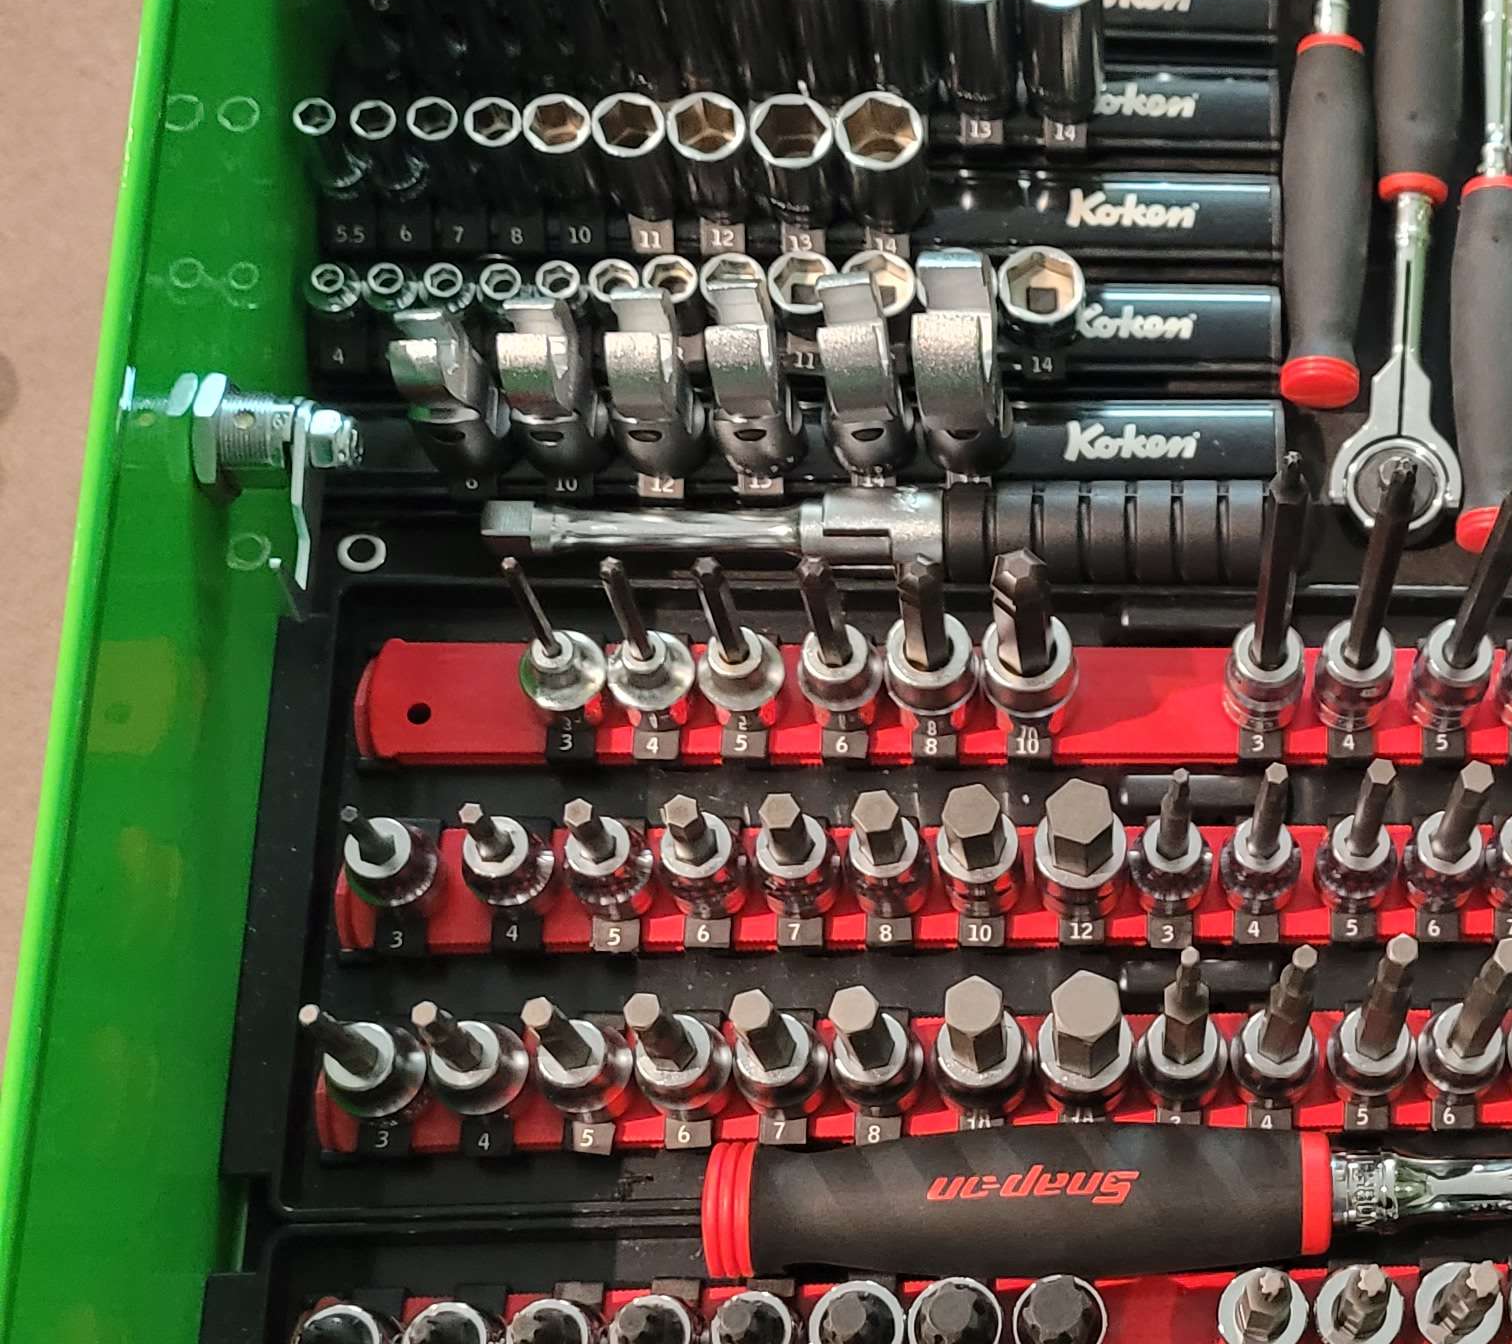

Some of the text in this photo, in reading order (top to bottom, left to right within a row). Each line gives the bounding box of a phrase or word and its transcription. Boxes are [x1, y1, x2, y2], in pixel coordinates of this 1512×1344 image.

[969, 121, 992, 139] 13
[1054, 124, 1076, 142] 14
[1067, 188, 1199, 229] Koken
[400, 226, 412, 242] 6
[454, 225, 465, 243] 7
[511, 227, 523, 245] 8
[568, 225, 592, 244] 10
[640, 230, 662, 249] 11
[710, 228, 734, 248] 12
[788, 234, 813, 252] 13
[332, 347, 345, 365] 4
[1031, 357, 1054, 374] 14
[1065, 421, 1199, 461] Koken
[560, 734, 572, 751] 3
[647, 736, 659, 754] 4
[735, 734, 748, 752] 5
[836, 736, 848, 754] 6
[924, 737, 938, 755] 8
[1015, 737, 1039, 756] 10
[1252, 736, 1264, 754] 3
[1342, 735, 1355, 753] 4
[1436, 734, 1448, 752] 5
[506, 924, 519, 943] 4
[697, 924, 710, 943] 6
[788, 923, 800, 942] 7
[879, 924, 892, 943] 8
[968, 924, 992, 944] 10
[1068, 919, 1094, 940] 12
[1162, 924, 1174, 943] 3
[1247, 921, 1260, 940] 4
[1345, 918, 1358, 937] 5
[1427, 920, 1440, 939] 6
[391, 931, 403, 949] 3
[608, 928, 620, 947] 5
[1356, 1108, 1369, 1127] 5
[1442, 1108, 1456, 1127] 6
[375, 1129, 389, 1148] 3
[581, 1128, 594, 1147] 5
[677, 1125, 690, 1144] 6
[773, 1121, 786, 1141] 7
[867, 1124, 880, 1143] 8
[478, 1132, 490, 1152] 4
[926, 1164, 1140, 1205] Snap-on
